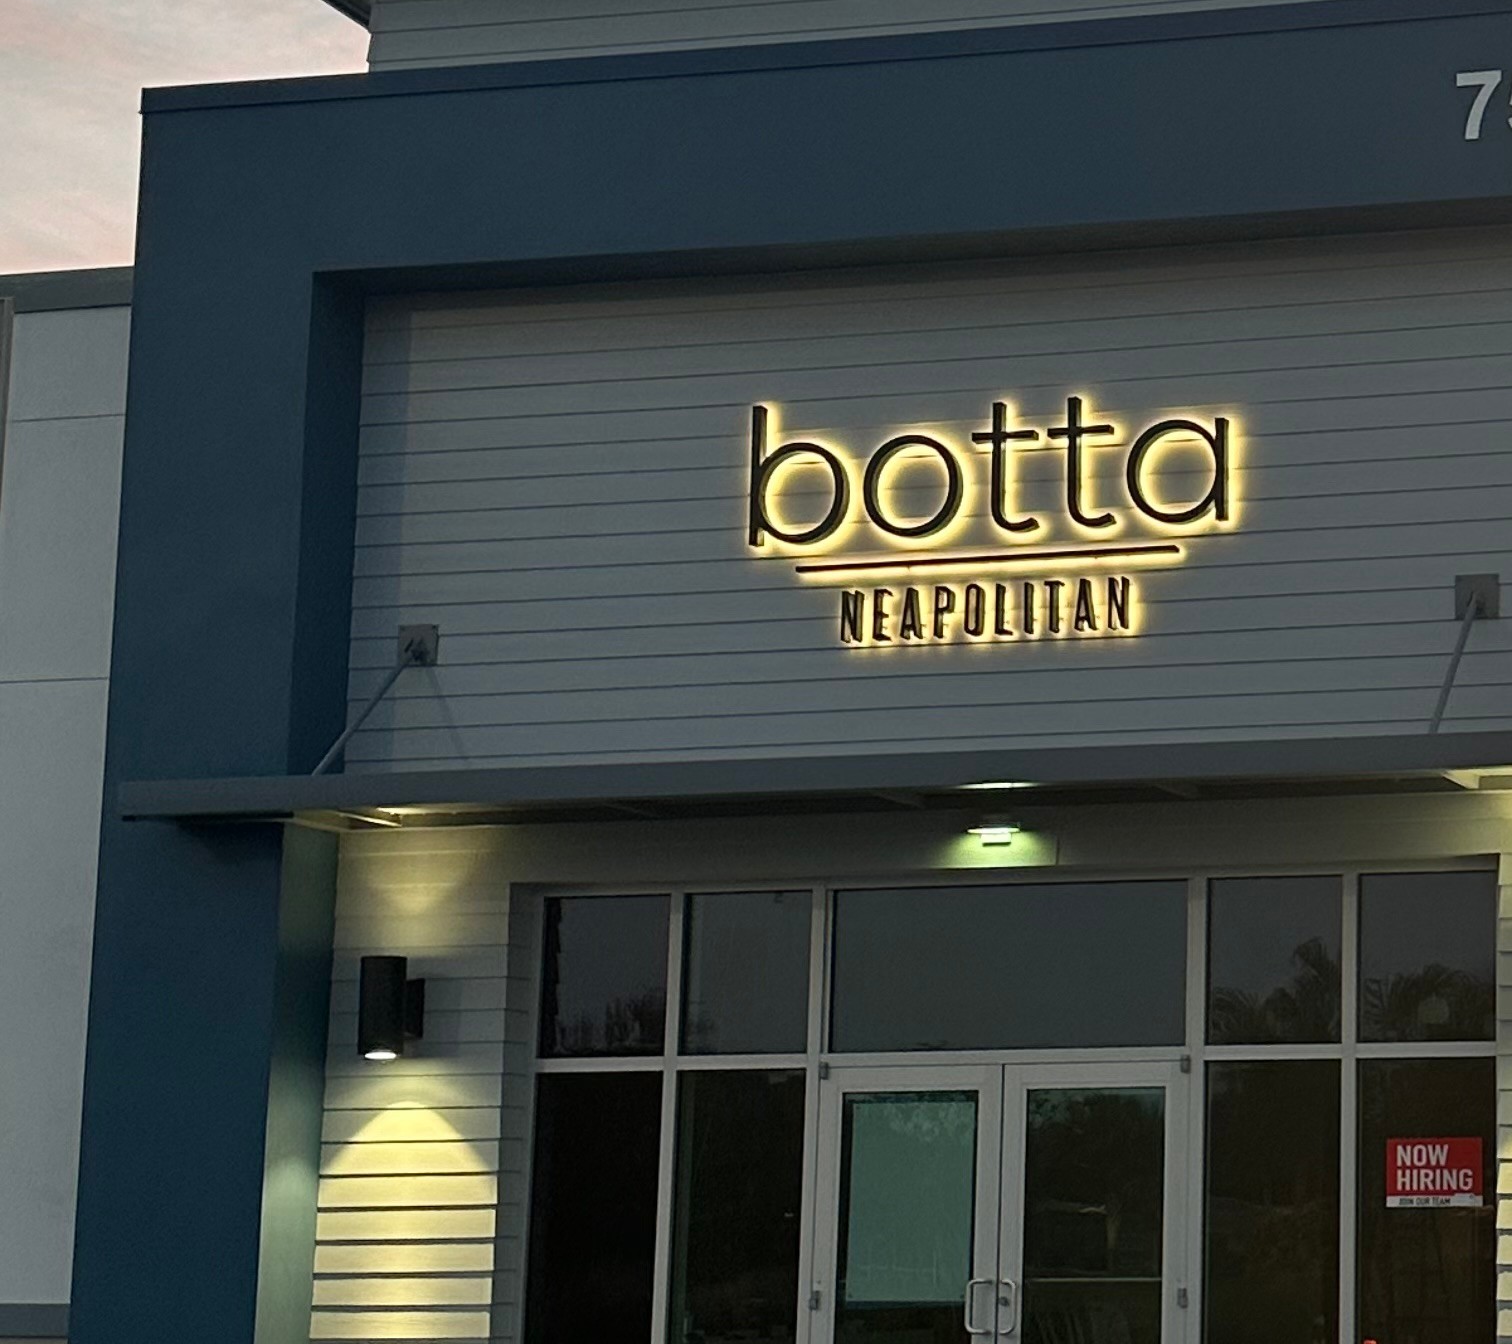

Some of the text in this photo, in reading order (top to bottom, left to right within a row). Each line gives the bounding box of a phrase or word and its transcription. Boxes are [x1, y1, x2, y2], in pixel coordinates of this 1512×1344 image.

[748, 396, 1230, 547] botta
[840, 576, 1131, 643] NEAPOLITAN
[1396, 1144, 1449, 1167] NOW
[1396, 1168, 1473, 1191] HIRING
[1416, 1197, 1430, 1205] OUR
[1432, 1197, 1451, 1205] TEAM
